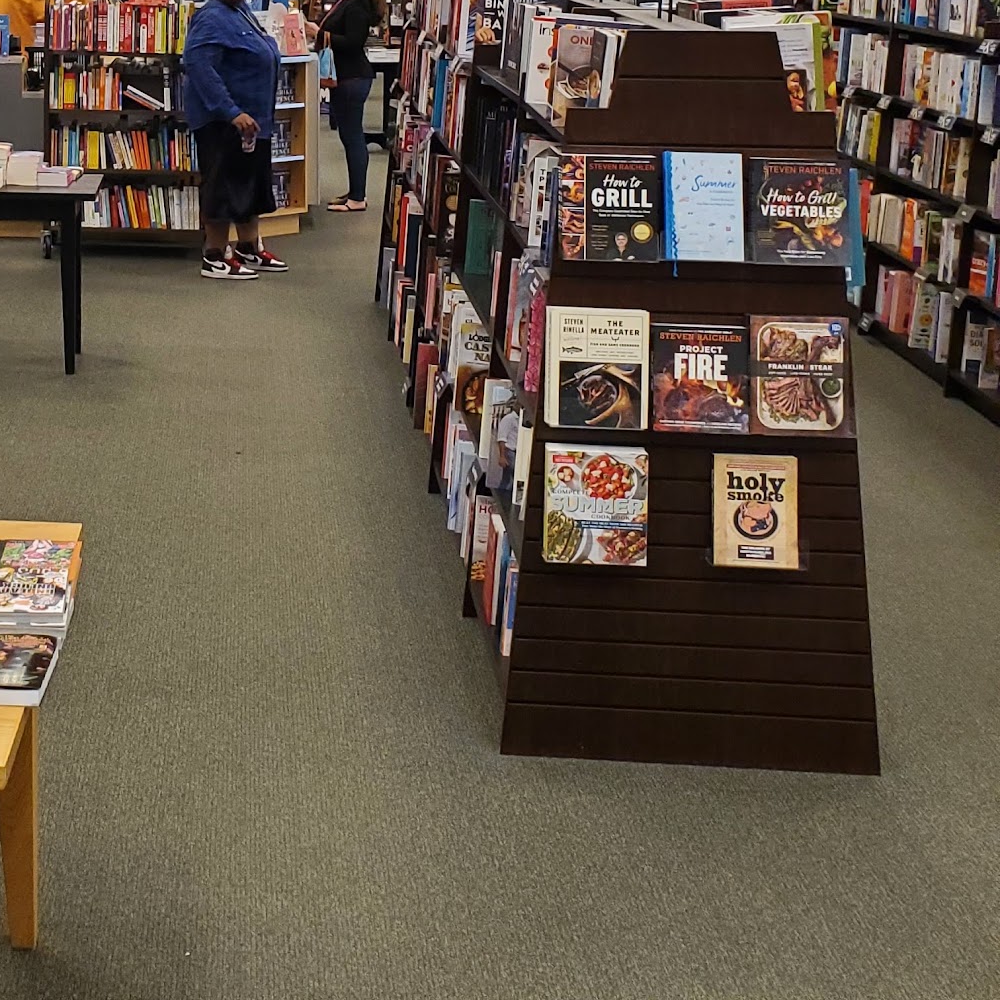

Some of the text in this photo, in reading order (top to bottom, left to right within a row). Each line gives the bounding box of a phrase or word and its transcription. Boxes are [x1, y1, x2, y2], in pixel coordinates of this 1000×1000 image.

[589, 163, 655, 171] STEVEN RAICHLEN
[763, 165, 842, 175] STEVEN RAICHLEN
[603, 174, 642, 188] How to
[691, 174, 737, 192] Summer
[591, 188, 653, 208] GRILL
[766, 187, 837, 204] How to Grill
[761, 204, 842, 219] VEGETABLES
[563, 326, 584, 334] RINELLA
[590, 328, 640, 336] MEATEATER
[660, 332, 742, 342] STEVEN RAICHLEN
[679, 345, 723, 354] PROJECT
[674, 352, 728, 381] FIRE
[726, 471, 786, 495] holy
[727, 487, 784, 502] smoke
[551, 495, 645, 515] SUMMER
